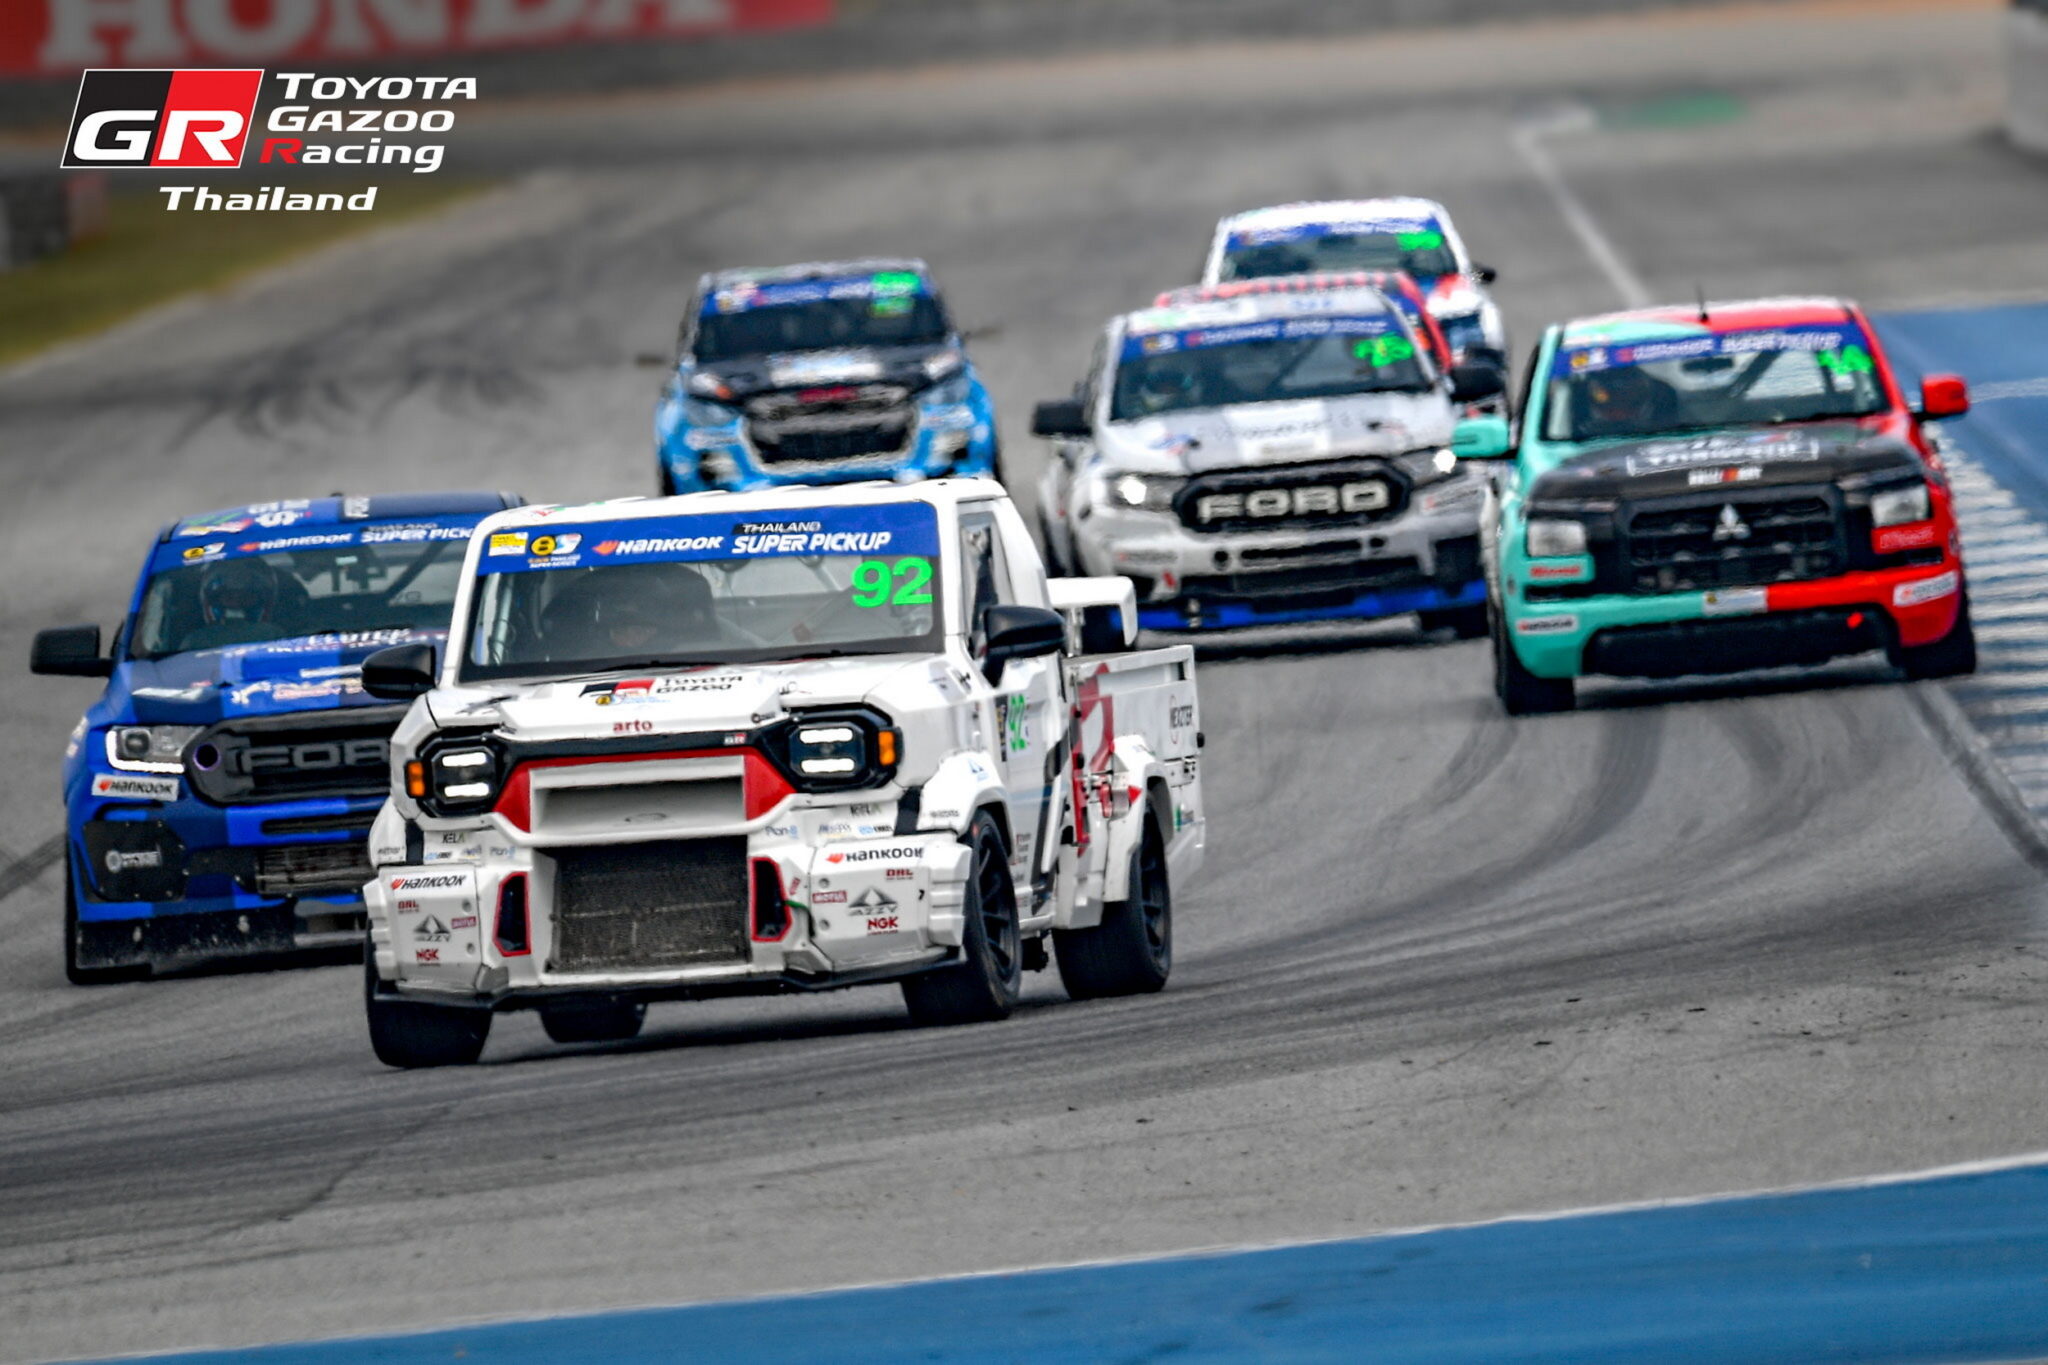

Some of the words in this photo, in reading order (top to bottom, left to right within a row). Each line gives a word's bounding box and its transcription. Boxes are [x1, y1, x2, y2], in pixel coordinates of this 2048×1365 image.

[1197, 480, 1389, 524] FORD
[743, 521, 821, 534] THAILAND
[361, 529, 427, 544] SUPER
[428, 528, 472, 541] PICK
[732, 533, 803, 555] SUPER
[808, 531, 892, 552] PICKUP
[851, 556, 933, 608] 92
[664, 676, 743, 687] TOYOTA
[613, 720, 653, 733] arto
[243, 740, 391, 774] FOR
[867, 916, 899, 930] NGK
[416, 949, 440, 961] NGK
